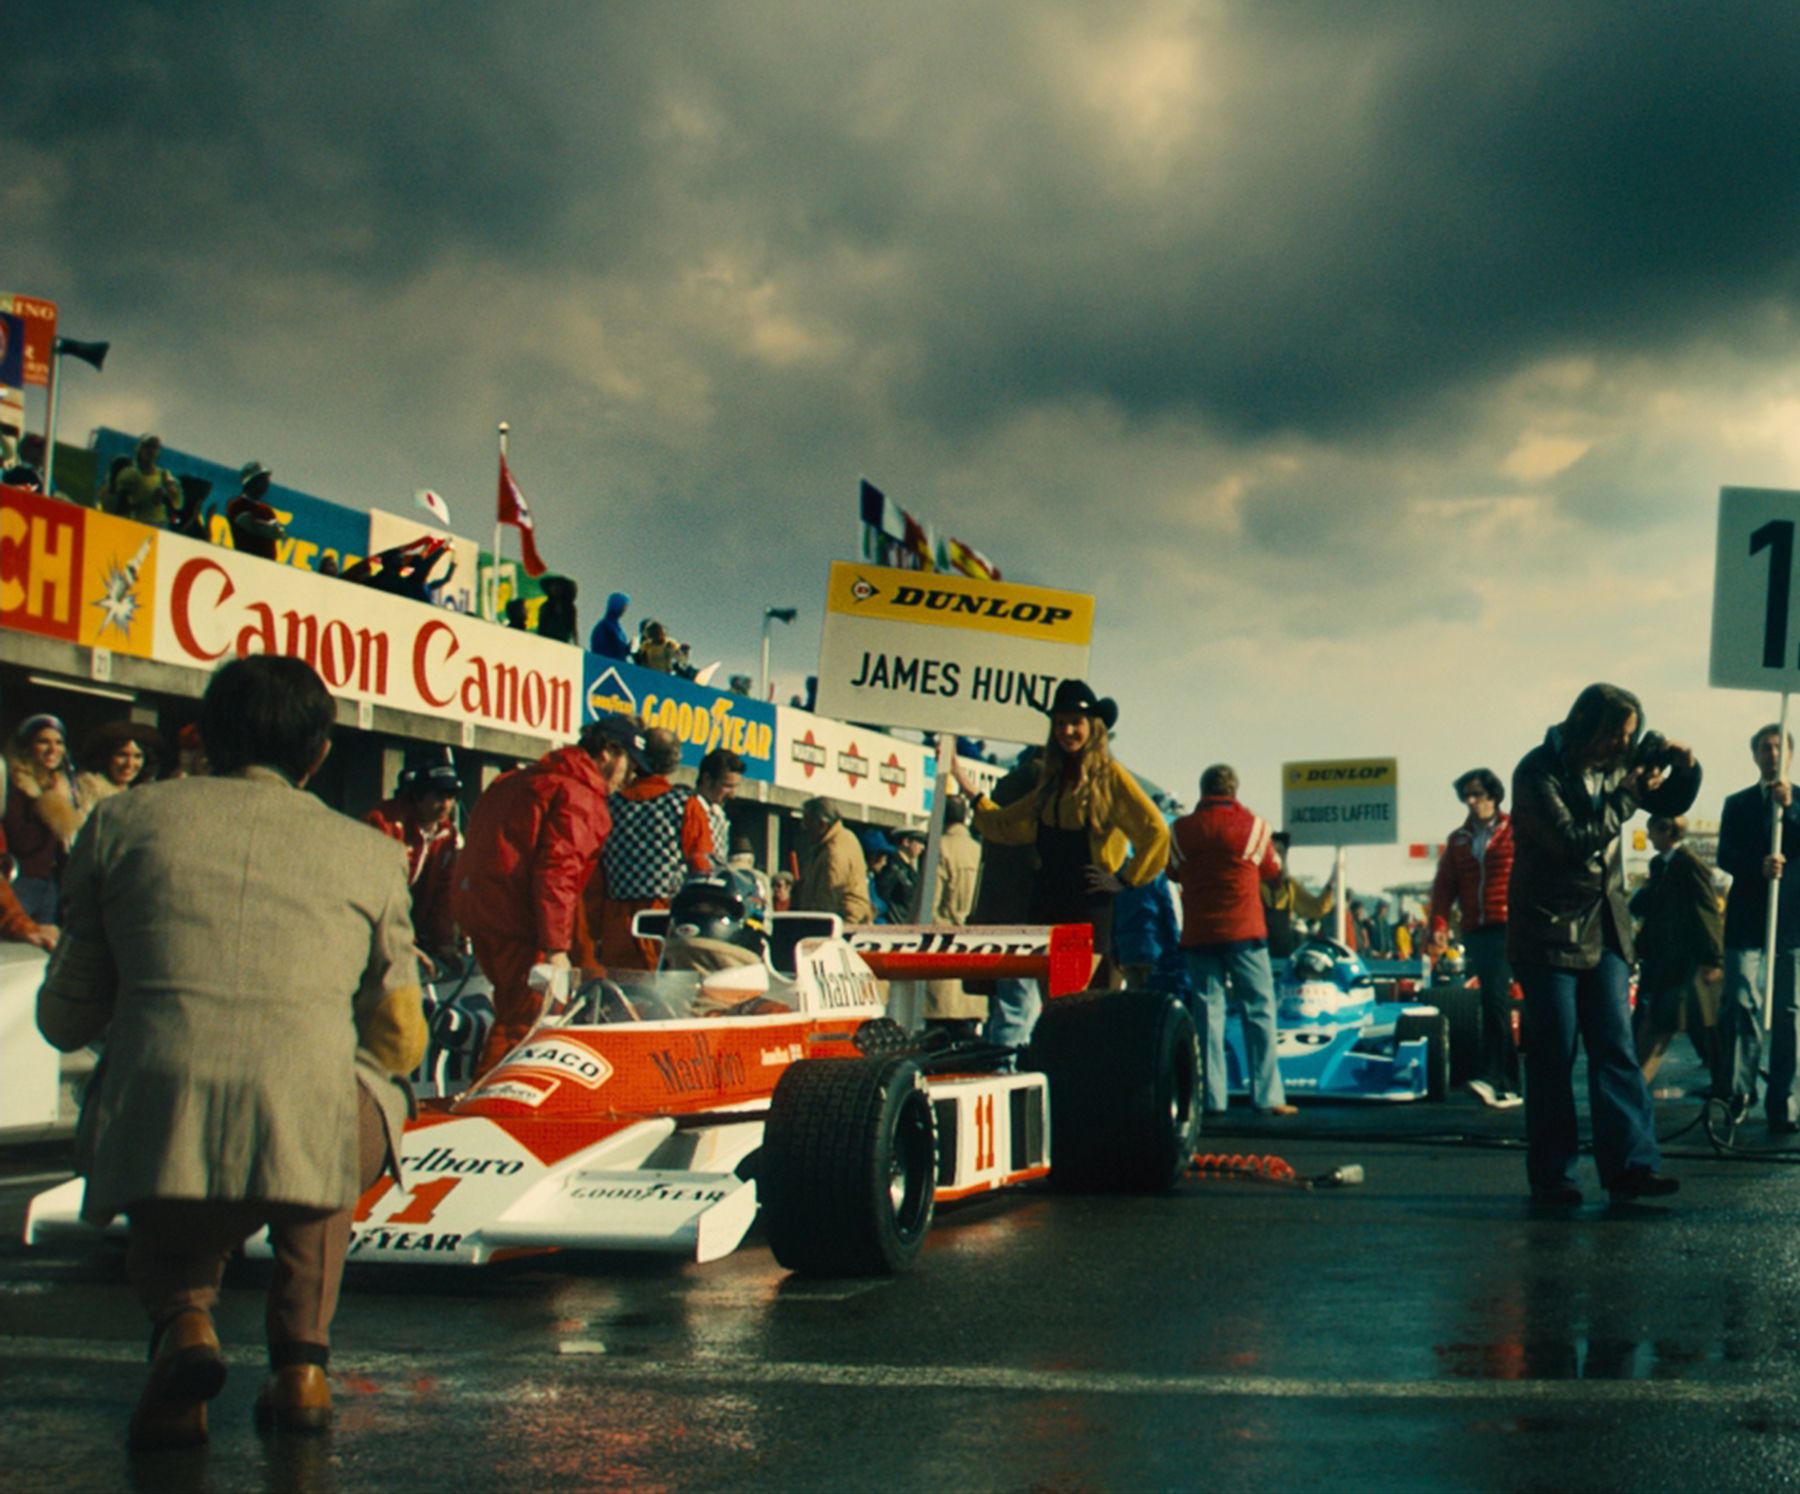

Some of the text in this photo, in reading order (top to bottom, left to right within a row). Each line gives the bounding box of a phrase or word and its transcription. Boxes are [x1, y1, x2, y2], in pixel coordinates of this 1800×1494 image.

[890, 585, 1073, 626] DUNLOP
[1749, 519, 1795, 669] 1
[170, 557, 572, 735] Canon Canon
[850, 651, 1058, 713] JAMES HUNT
[1306, 766, 1389, 782] DUNLOP
[401, 1147, 524, 1176] rlboro
[975, 1093, 995, 1172] 11
